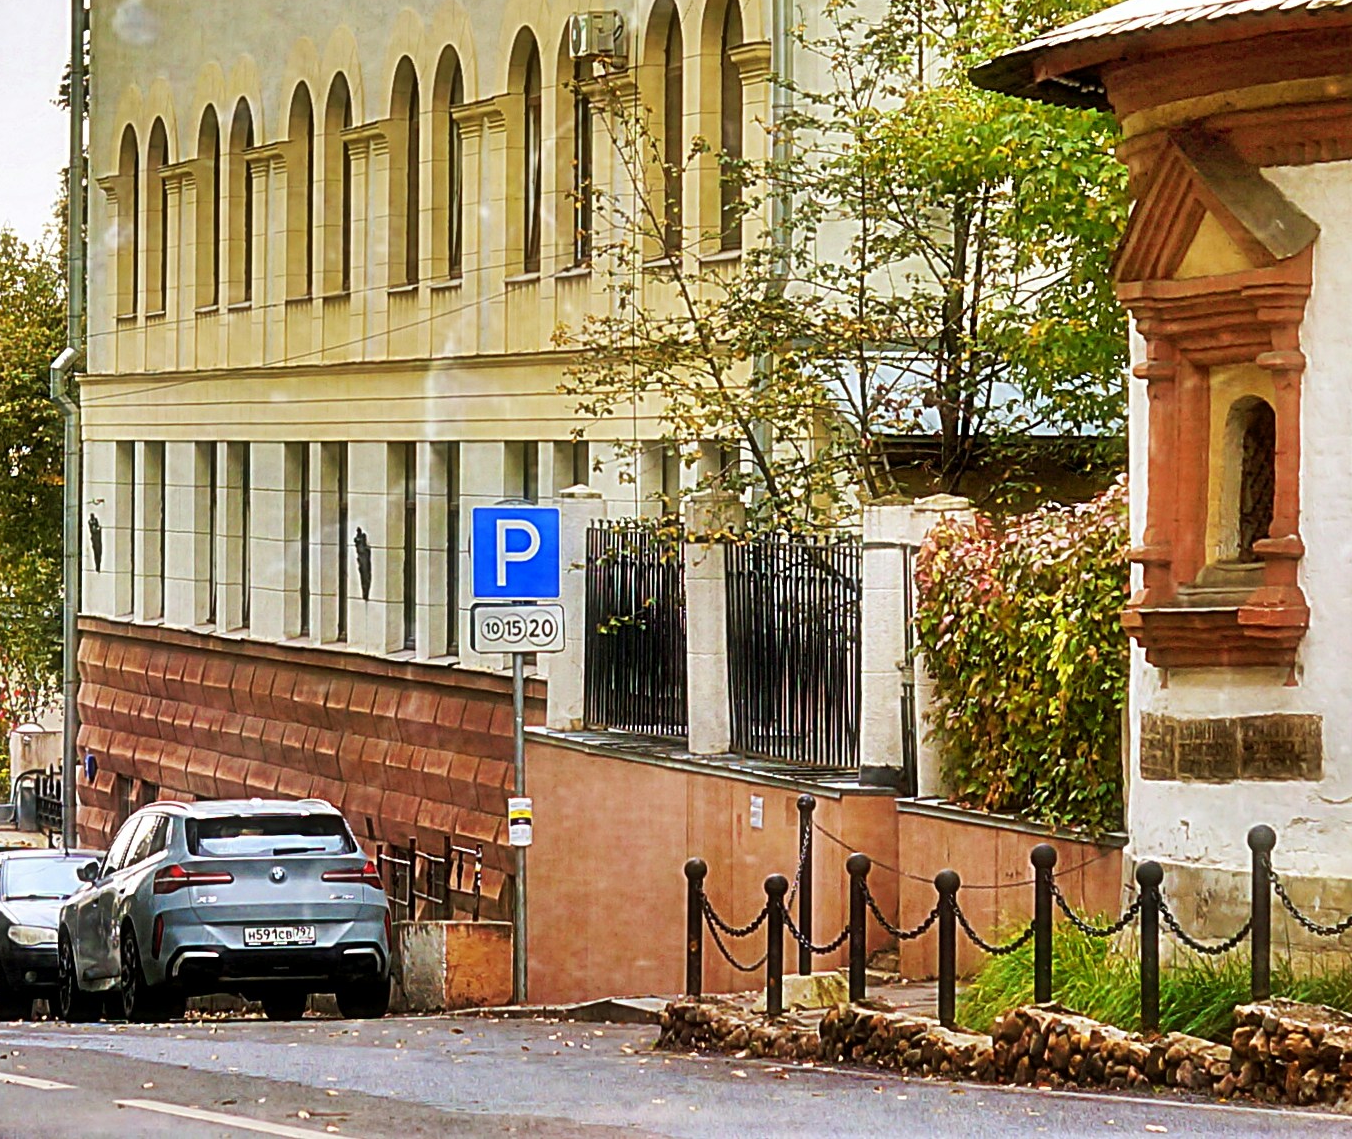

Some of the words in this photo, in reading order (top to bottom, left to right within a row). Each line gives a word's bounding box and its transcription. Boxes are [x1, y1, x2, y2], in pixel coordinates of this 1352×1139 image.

[496, 518, 541, 587] P
[485, 622, 500, 635] 10
[505, 620, 522, 637] 15
[529, 619, 553, 638] 20
